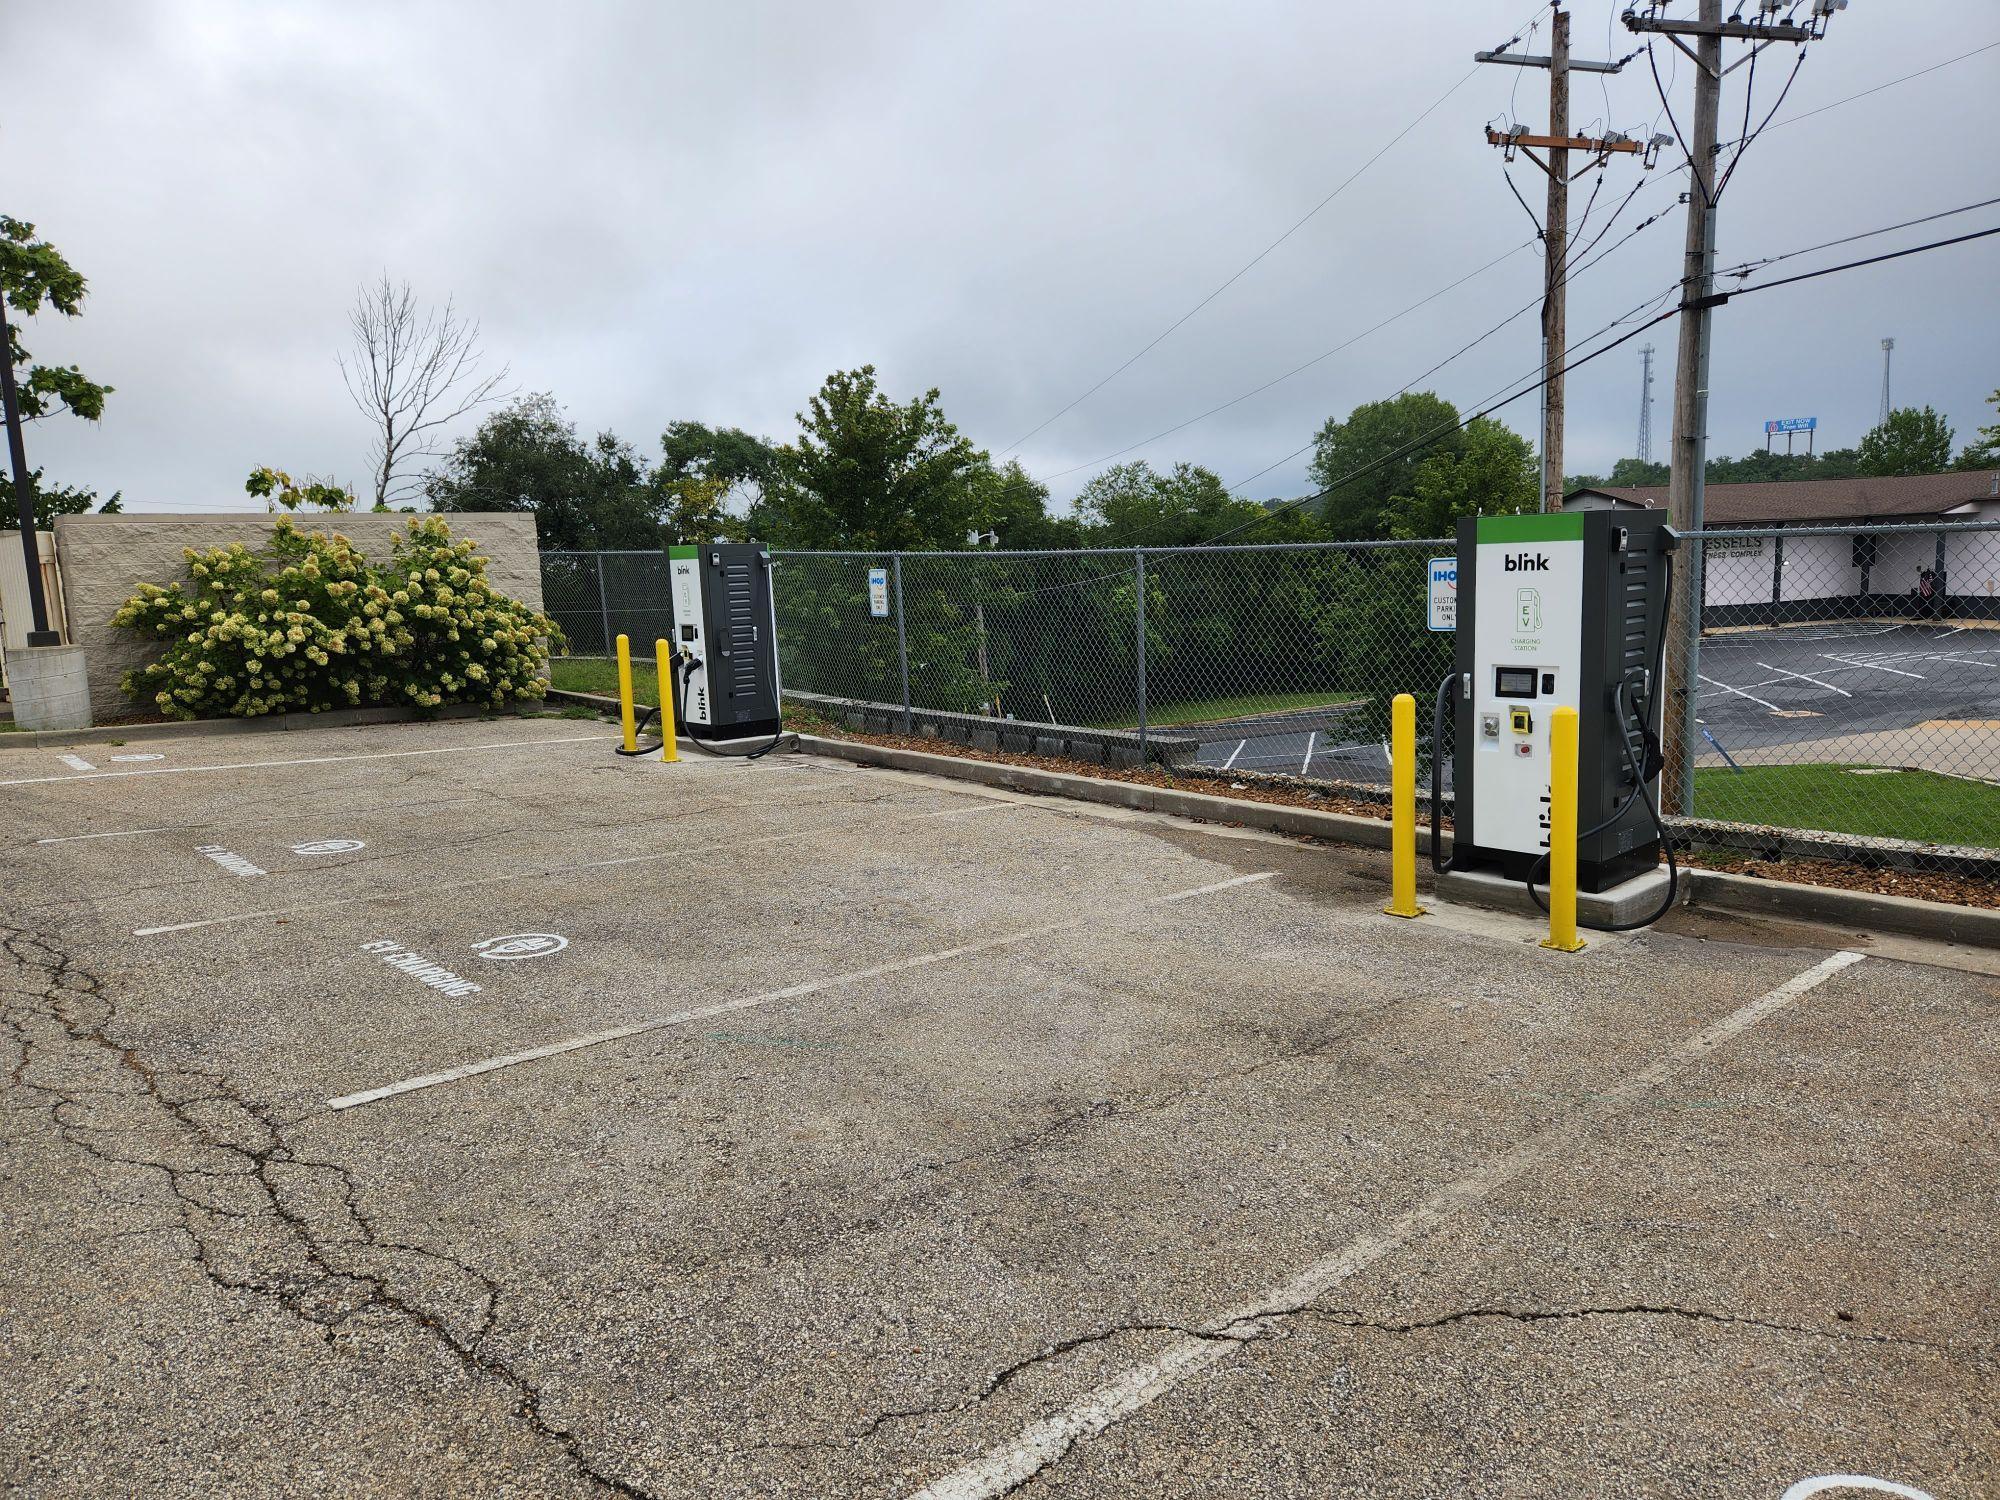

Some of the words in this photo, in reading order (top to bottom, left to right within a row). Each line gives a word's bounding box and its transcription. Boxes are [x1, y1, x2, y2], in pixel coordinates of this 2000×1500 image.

[1731, 549, 1763, 558] COMPLEX
[677, 564, 690, 574] blink
[1504, 552, 1549, 572] blink
[697, 686, 707, 720] blink
